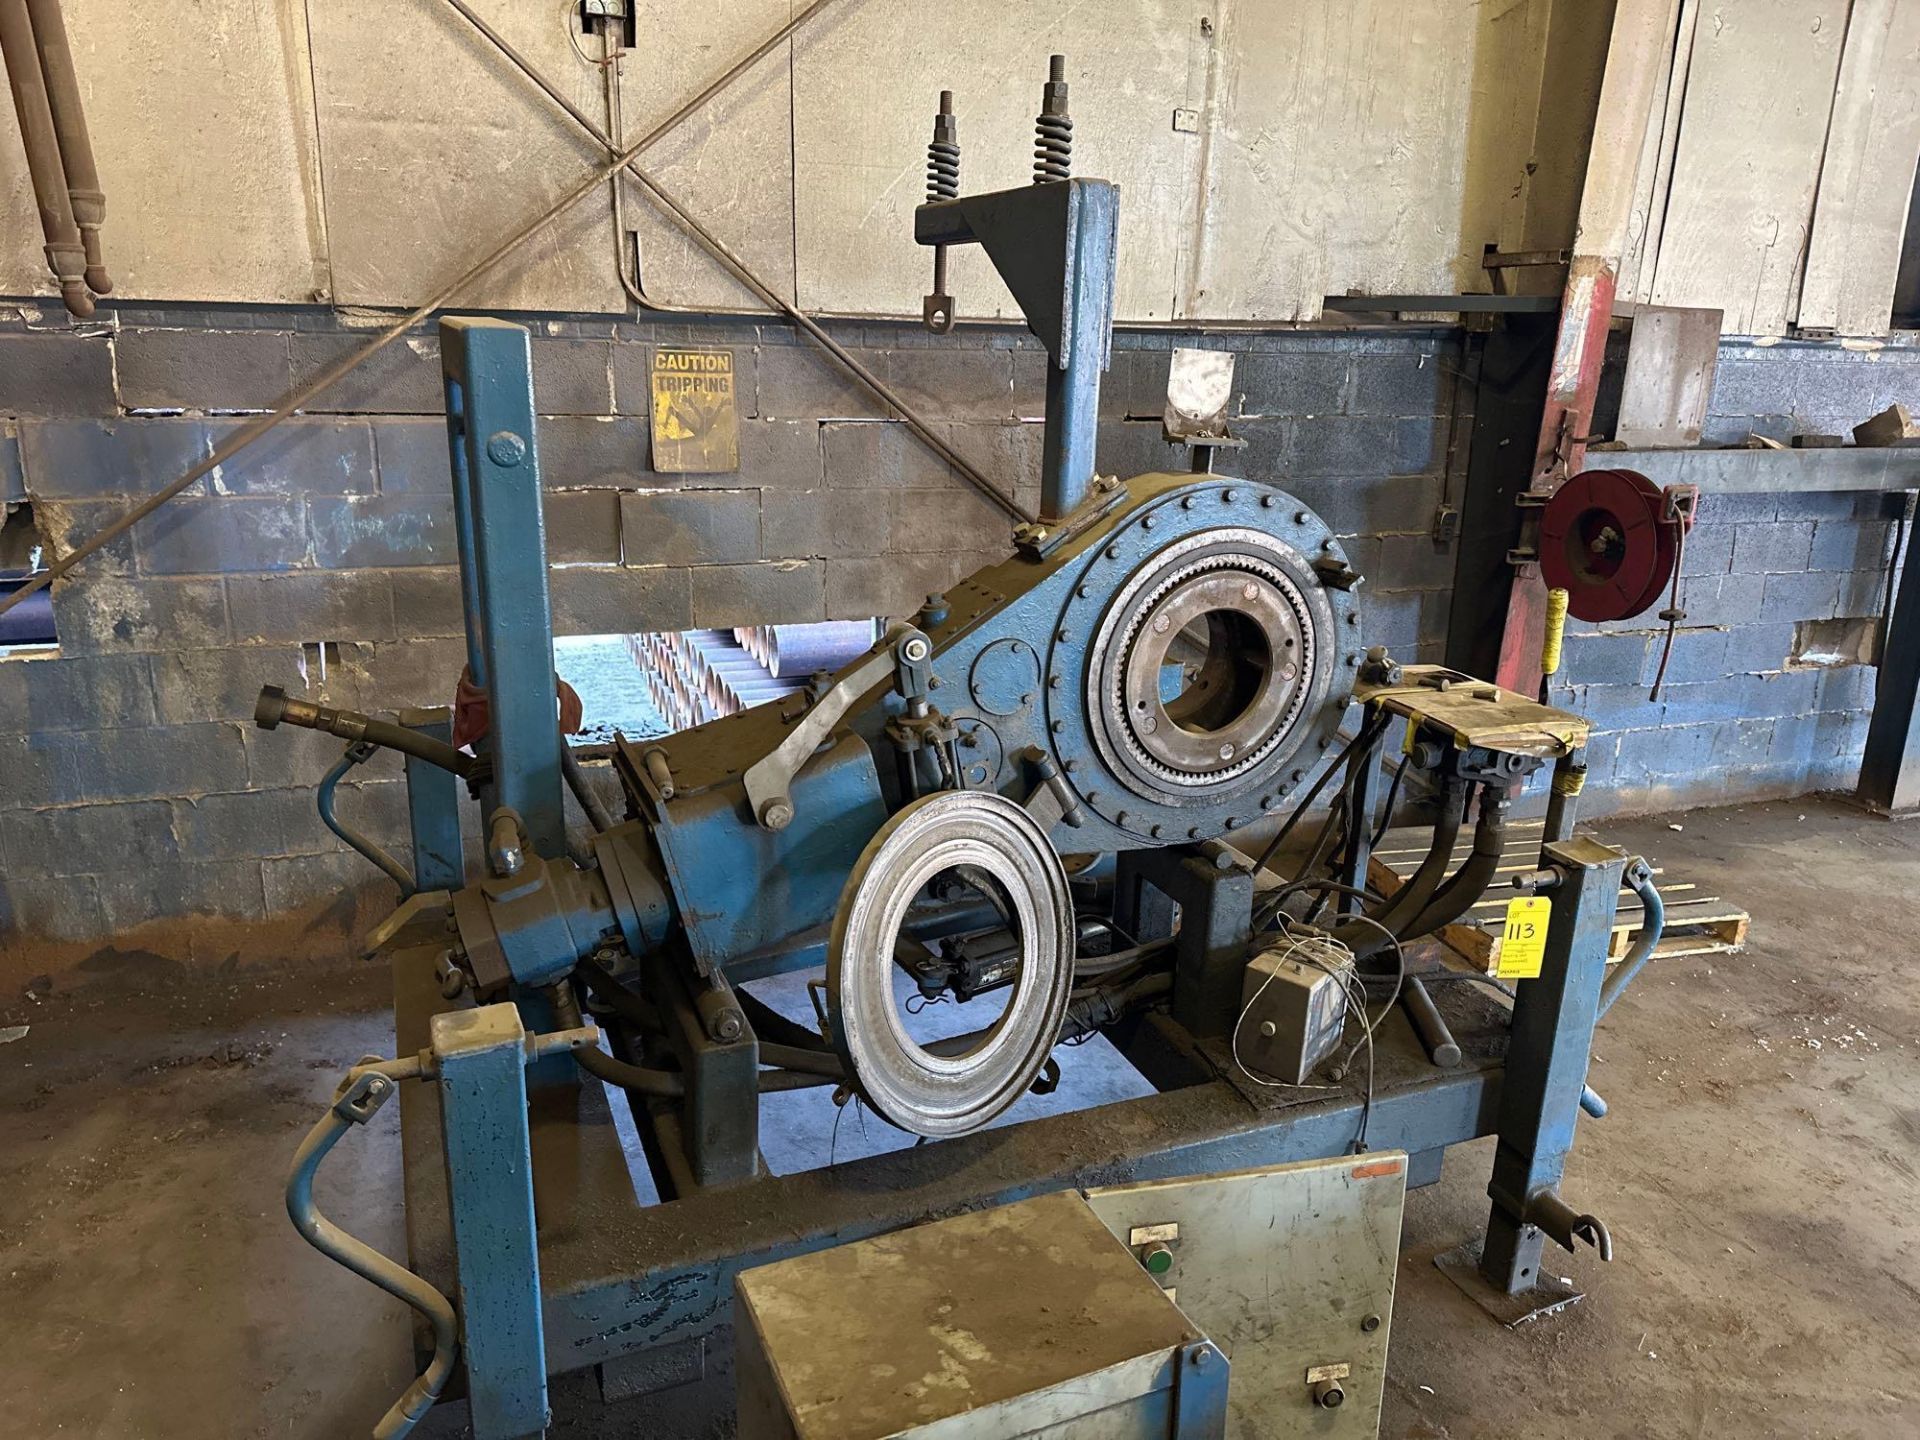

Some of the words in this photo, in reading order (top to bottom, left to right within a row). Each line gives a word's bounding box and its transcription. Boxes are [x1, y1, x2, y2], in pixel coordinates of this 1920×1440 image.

[655, 353, 729, 371] CAUTION
[656, 376, 729, 393] TRIPPING
[1508, 922, 1535, 940] 113
